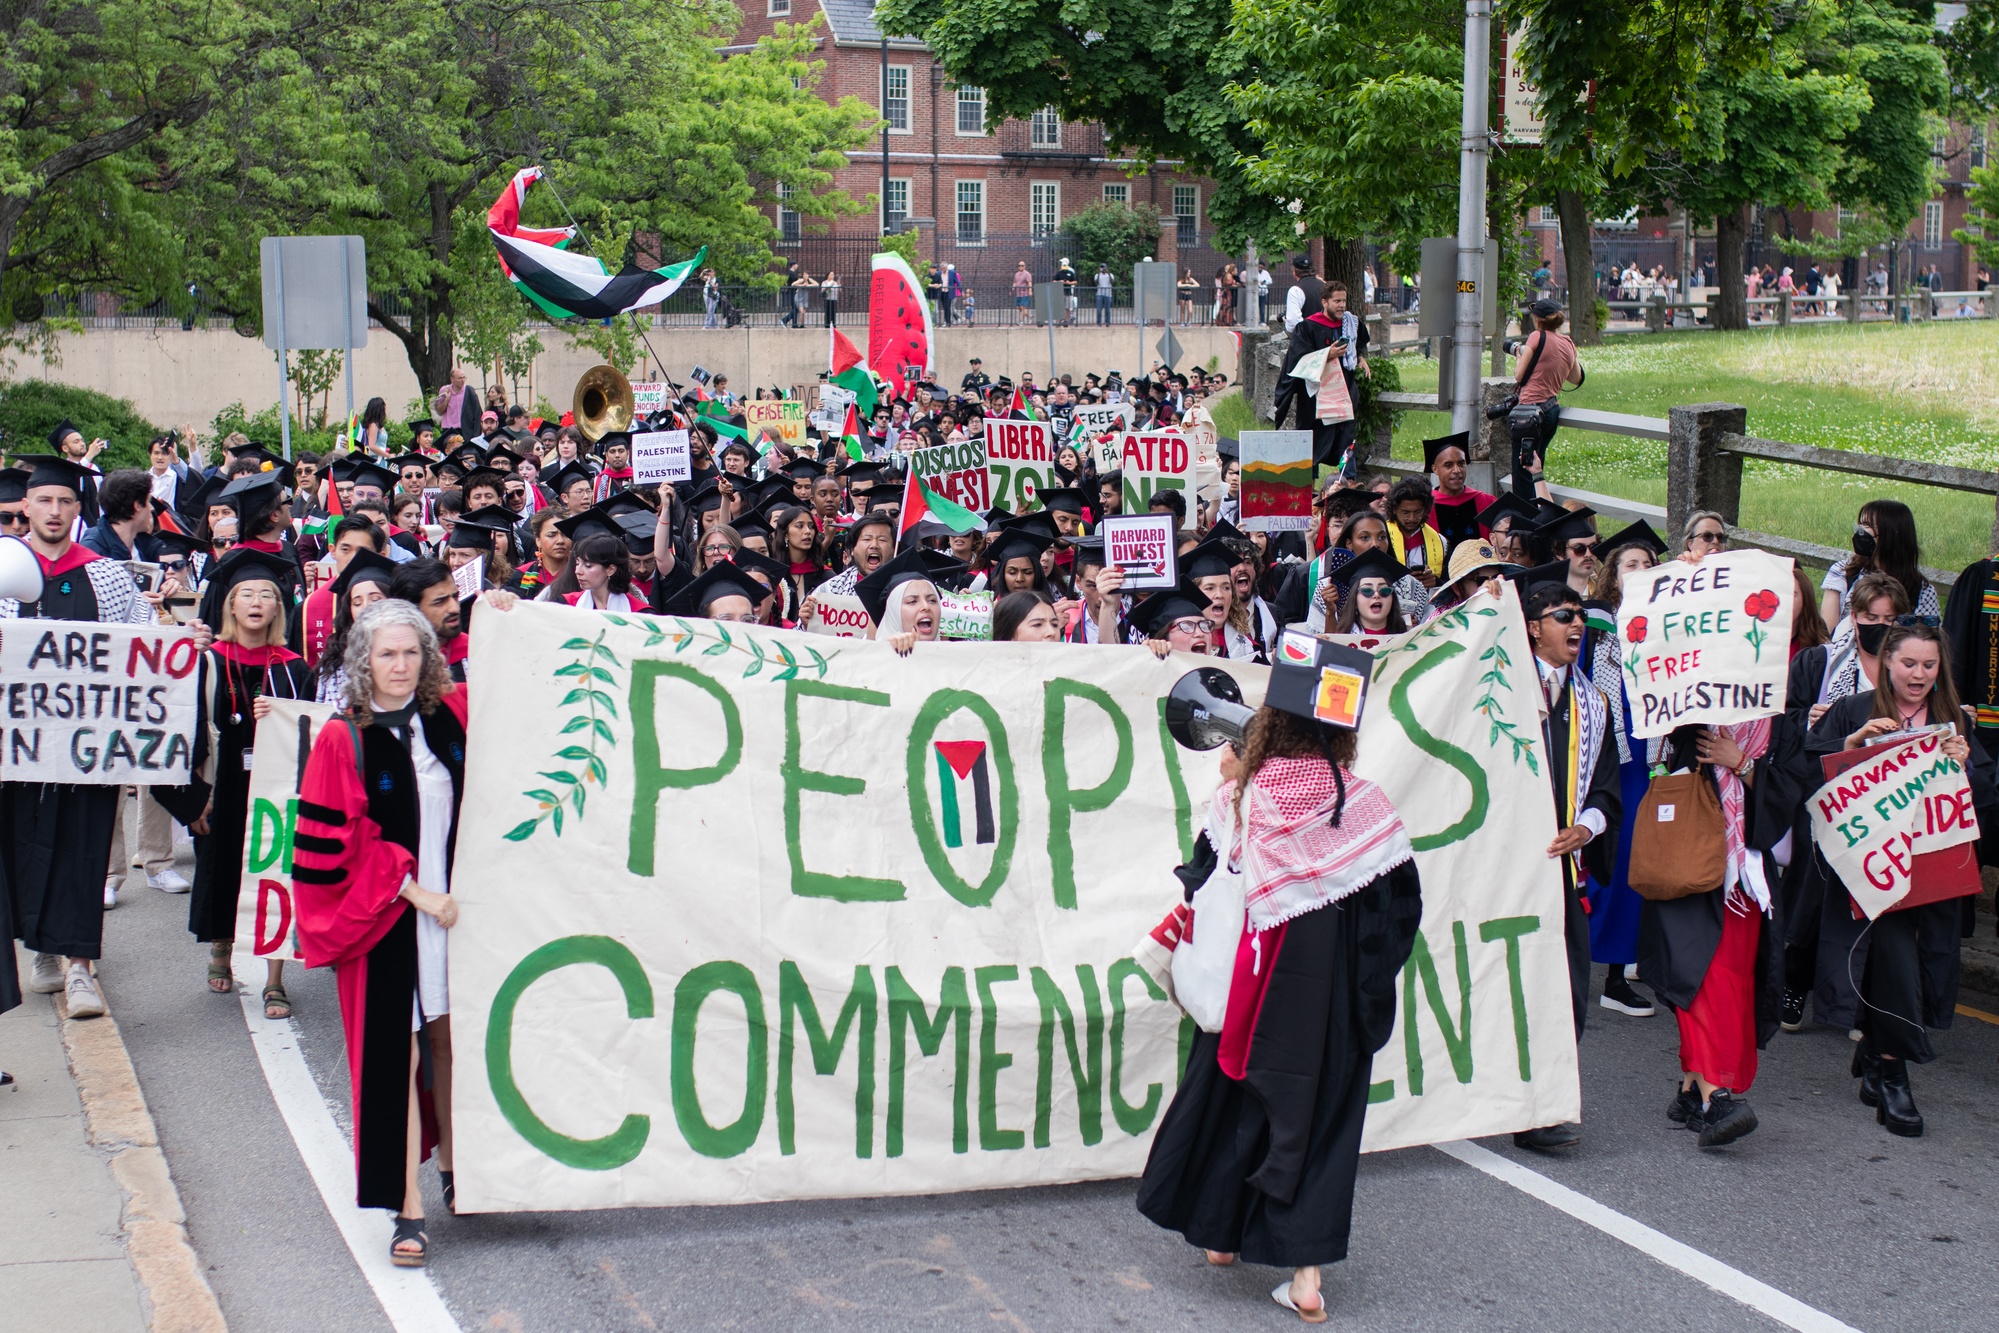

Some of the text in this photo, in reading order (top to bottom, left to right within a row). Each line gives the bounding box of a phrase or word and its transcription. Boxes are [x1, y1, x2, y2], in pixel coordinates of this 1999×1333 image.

[875, 277, 885, 304] FREE
[873, 310, 883, 368] PALESTINE
[634, 402, 661, 411] ENOCIDE
[747, 402, 805, 425] CEASEFIRE
[791, 385, 820, 410] DIVE
[637, 446, 685, 457] PALESTINE
[912, 440, 988, 476] DISCLOS
[986, 423, 1053, 462] LIBER
[1122, 435, 1189, 474] ATED
[638, 467, 686, 478] PALESTINE
[989, 463, 1056, 512] ZO
[1111, 528, 1166, 543] HARVARD
[1112, 542, 1166, 561] DIVEST
[1648, 567, 1731, 605] FREE
[817, 603, 869, 629] 40,000
[939, 613, 990, 634] estine
[963, 600, 988, 613] cho
[316, 620, 324, 660] HARV
[1662, 609, 1734, 643] FREE
[27, 630, 198, 680] ARE NO
[1646, 649, 1701, 683] FREE
[1987, 614, 1999, 705] UNIVERSITY
[0, 682, 168, 725] ERSITIES
[1193, 708, 1210, 721] PYLE
[1642, 681, 1774, 728] PALESTINE
[71, 726, 190, 774] GAZA
[1836, 815, 1869, 848] IS
[1863, 787, 1976, 891] GEIDE
[485, 915, 1541, 1171] COMMENCNT
